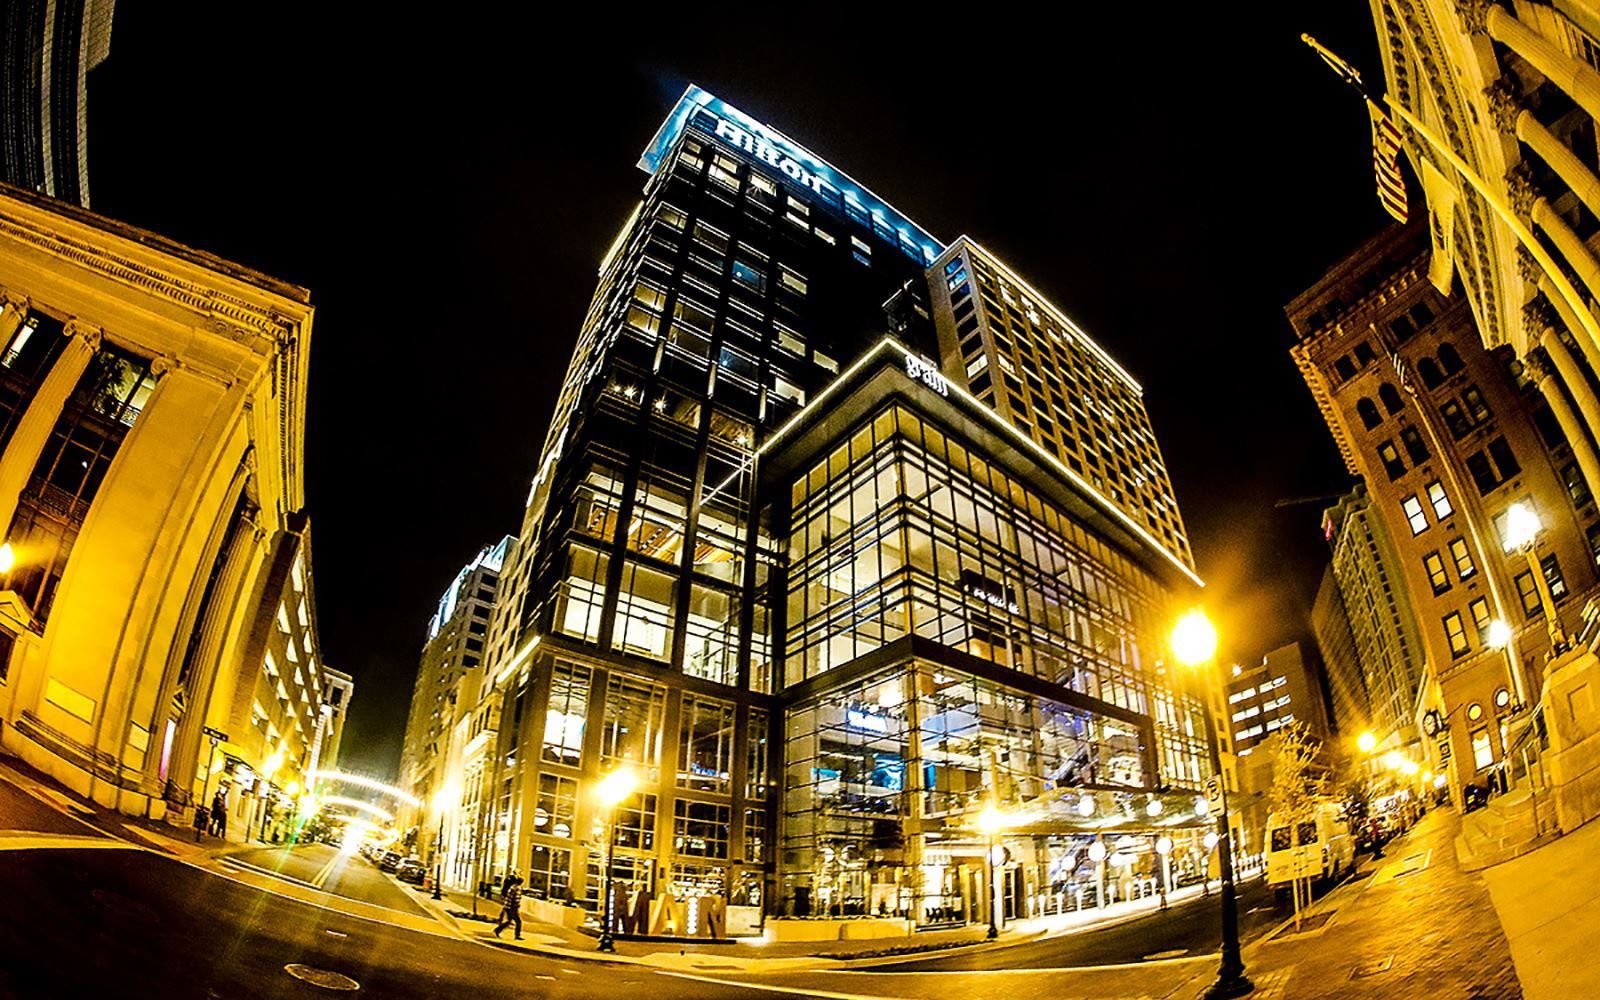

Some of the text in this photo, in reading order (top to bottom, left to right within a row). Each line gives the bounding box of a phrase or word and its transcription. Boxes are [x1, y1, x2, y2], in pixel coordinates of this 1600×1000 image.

[715, 119, 823, 195] Hilton
[905, 354, 948, 397] grain
[609, 880, 726, 938] MAIN
